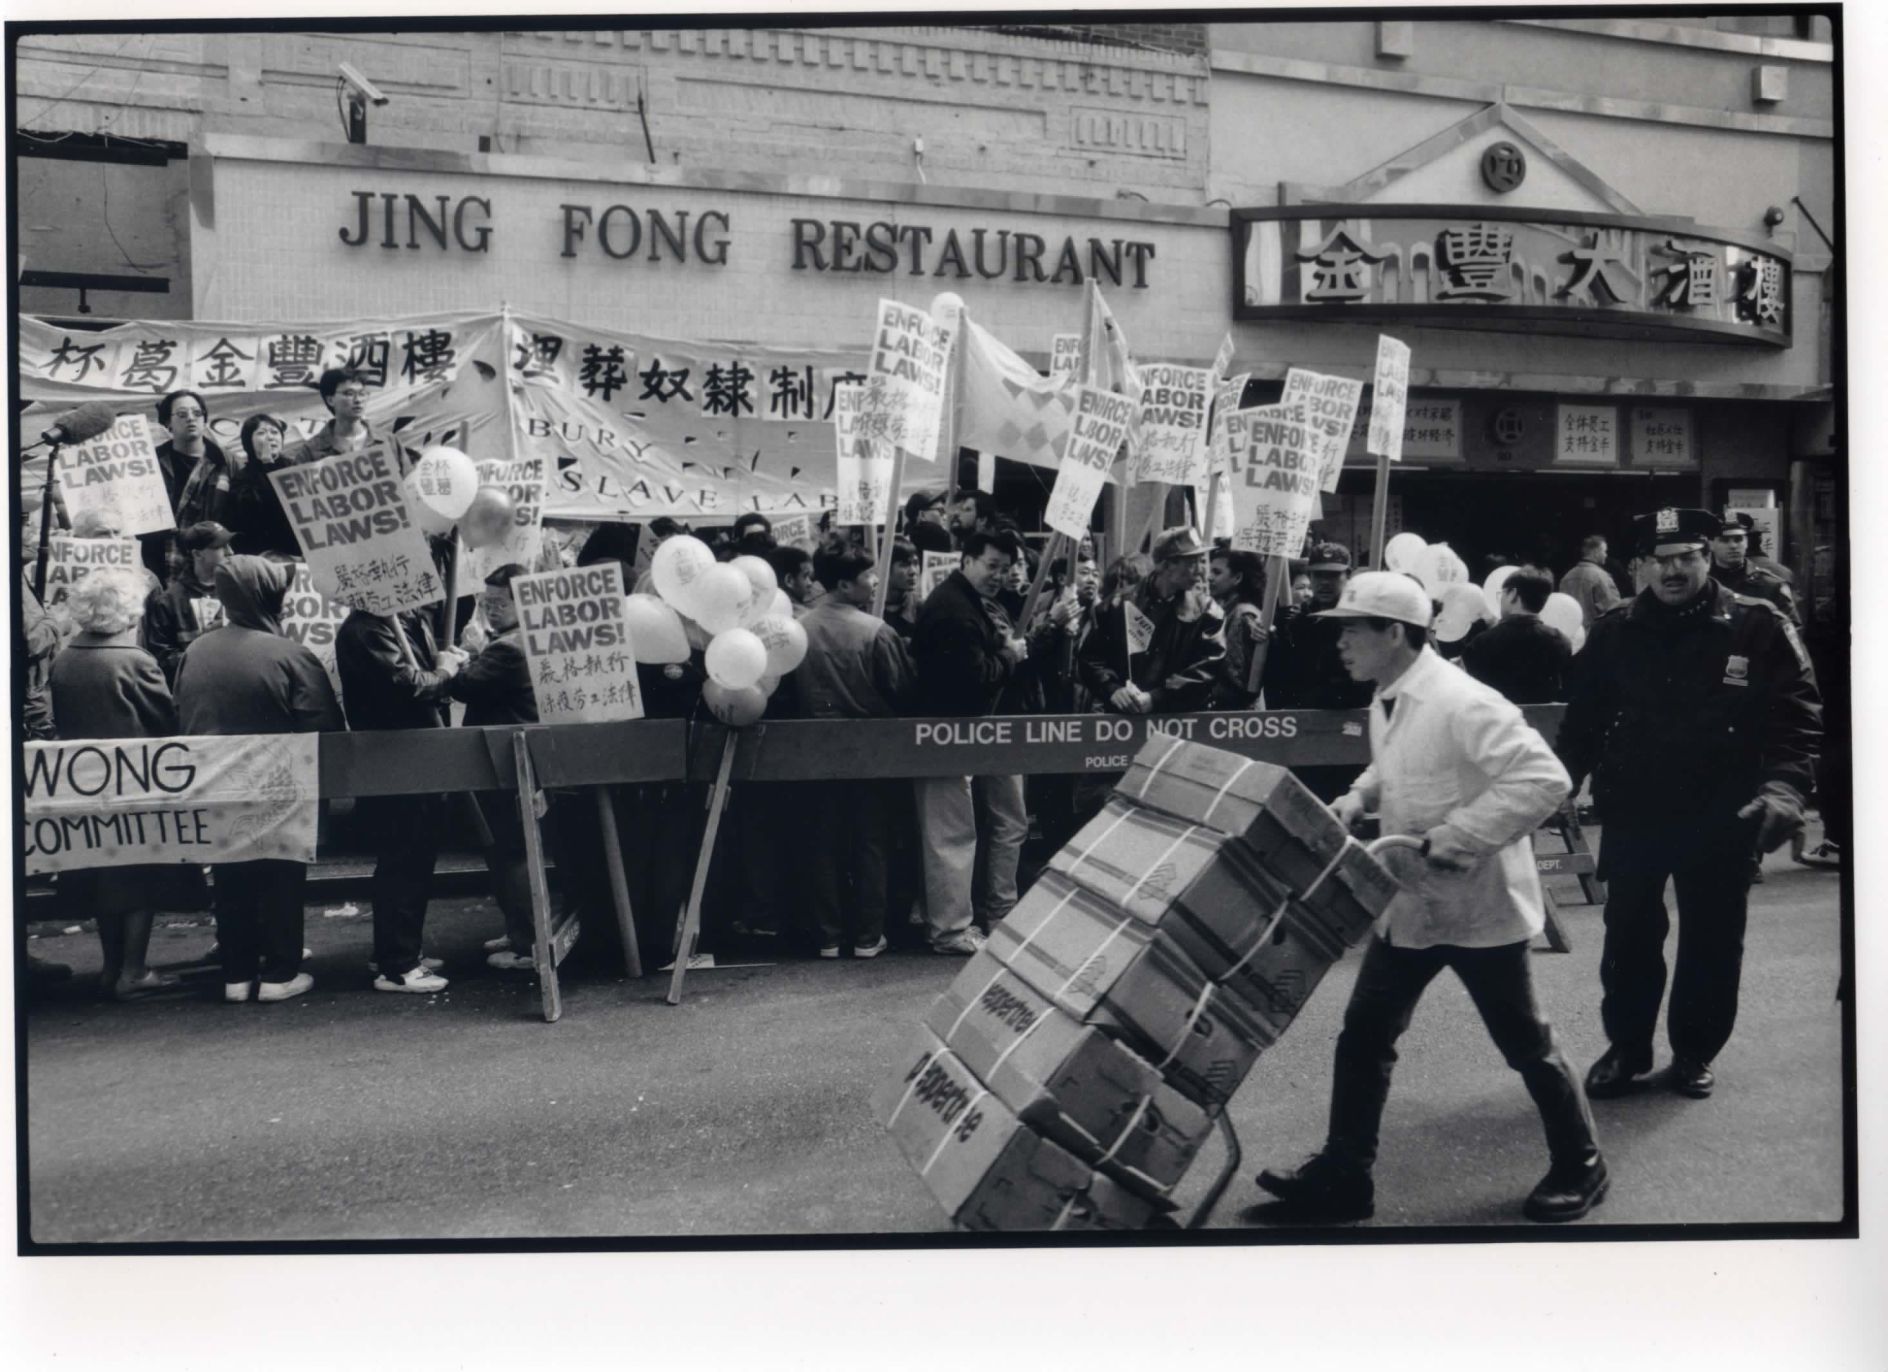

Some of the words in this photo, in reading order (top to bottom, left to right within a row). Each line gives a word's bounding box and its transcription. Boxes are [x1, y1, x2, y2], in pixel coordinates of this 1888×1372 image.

[338, 190, 493, 253] JING
[559, 203, 732, 266] FONG
[790, 218, 1156, 289] RESTAURANT
[1295, 221, 1785, 324] 金豐大酒樓
[1139, 367, 1207, 391] NFORCE
[1140, 389, 1205, 410] ABOR
[1140, 407, 1203, 429] AWS!
[528, 418, 652, 458] BURY
[59, 440, 150, 470] LABOR
[63, 459, 156, 489] LAWS!
[277, 451, 391, 500] ENFORCE
[476, 460, 542, 483] NFORCE
[289, 480, 402, 525] LABOR
[559, 470, 717, 509] SLAVE
[752, 492, 838, 512] LAB
[300, 506, 411, 551] LAWS!
[772, 520, 806, 541] ORCE
[49, 541, 133, 565] NFORCE
[517, 568, 617, 607] ENFORCE
[283, 597, 343, 620] BOR
[522, 597, 622, 631] LABOR
[528, 622, 627, 657] LAWS!
[915, 721, 1012, 745] POLICE
[1026, 721, 1082, 743] LINE
[1096, 719, 1133, 741] DO
[1146, 718, 1198, 740] NOT
[1209, 716, 1298, 739] CROSS
[24, 742, 196, 798] WONG
[1085, 755, 1128, 768] POLICE
